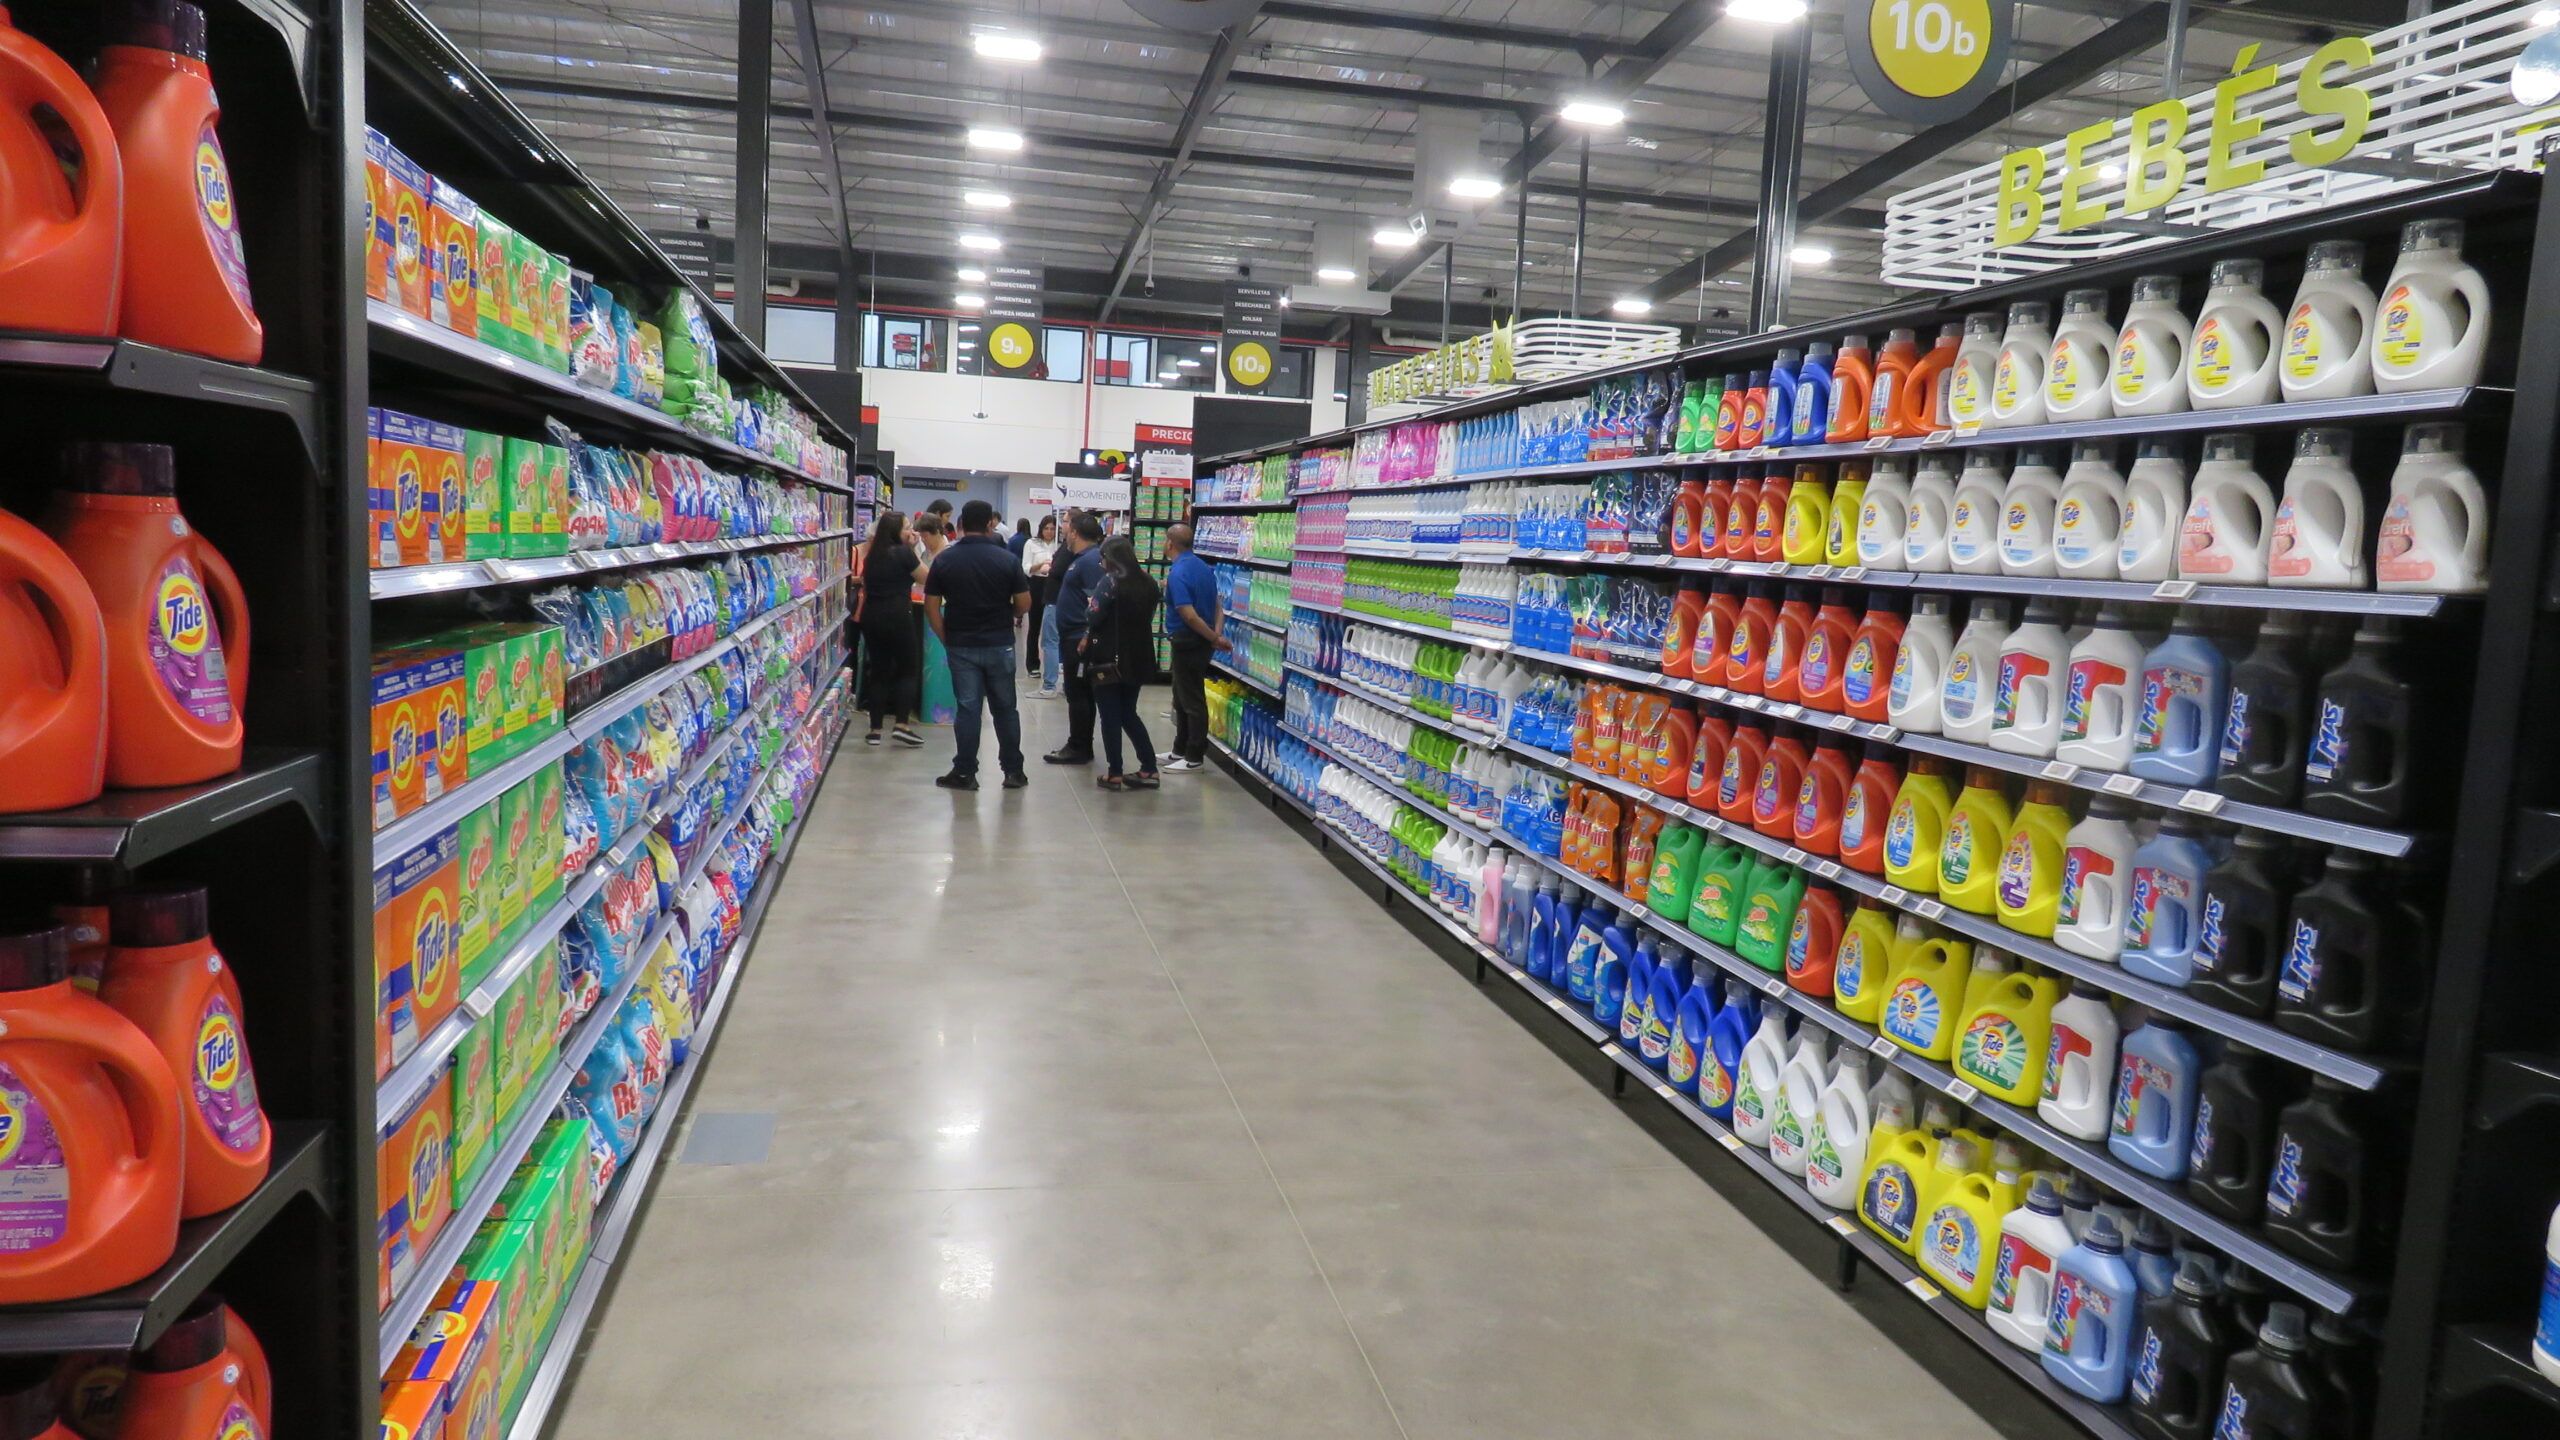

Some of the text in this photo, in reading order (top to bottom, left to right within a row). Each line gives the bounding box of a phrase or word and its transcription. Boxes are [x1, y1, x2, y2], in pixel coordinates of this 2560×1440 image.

[1889, 1, 1975, 55] 10b
[1994, 37, 2372, 247] BEBÉS
[201, 165, 226, 203] Tide
[688, 240, 705, 248] ORAL
[447, 243, 468, 285] Tide
[1234, 301, 1271, 310] DESECHABLES
[1237, 288, 1271, 296] SERVILLETAS
[1016, 311, 1036, 319] HOGAR
[1226, 328, 1251, 336] CONTROL
[1242, 315, 1263, 323] BOLSAS
[2291, 326, 2309, 341] Tide
[2386, 310, 2409, 327] Tide
[1001, 337, 1023, 356] 9a
[2201, 338, 2219, 353] Tide
[398, 470, 420, 515] Tide
[440, 477, 461, 514] Tide
[1069, 489, 1128, 502] DROMEINTER
[2007, 509, 2027, 526] Tide
[2060, 506, 2080, 525] Tide
[165, 595, 203, 642] Tide
[1952, 660, 1969, 677] Tide
[2000, 660, 2016, 706] MAS
[2069, 670, 2087, 718] MAS
[2140, 679, 2161, 731] MAS
[437, 707, 460, 748] Tide
[2227, 687, 2249, 747] MAS
[2317, 697, 2345, 763] MAS
[391, 722, 416, 778] Tide
[2063, 857, 2080, 902] MAS
[2130, 876, 2151, 931] MAS
[2200, 893, 2226, 954] MAS
[417, 912, 447, 996] Tide
[2289, 918, 2319, 982] MAS
[1902, 997, 1918, 1014] Tide
[202, 1032, 236, 1083] Tide
[1981, 1032, 2005, 1053] Tide
[2116, 1066, 2133, 1116] MAS
[1735, 1107, 1753, 1128] ARIEL
[1772, 1134, 1792, 1157] ARIEL
[411, 1132, 443, 1221] Tide
[1808, 1163, 1830, 1188] ARIEL
[2276, 1134, 2302, 1202] MAS
[1881, 1182, 1901, 1204] Tide
[1877, 1207, 1894, 1227] OXI
[1940, 1226, 1961, 1248] Tide
[1998, 1241, 2016, 1293] MAS
[2054, 1282, 2072, 1334] MAS
[2140, 1326, 2163, 1392] MAS
